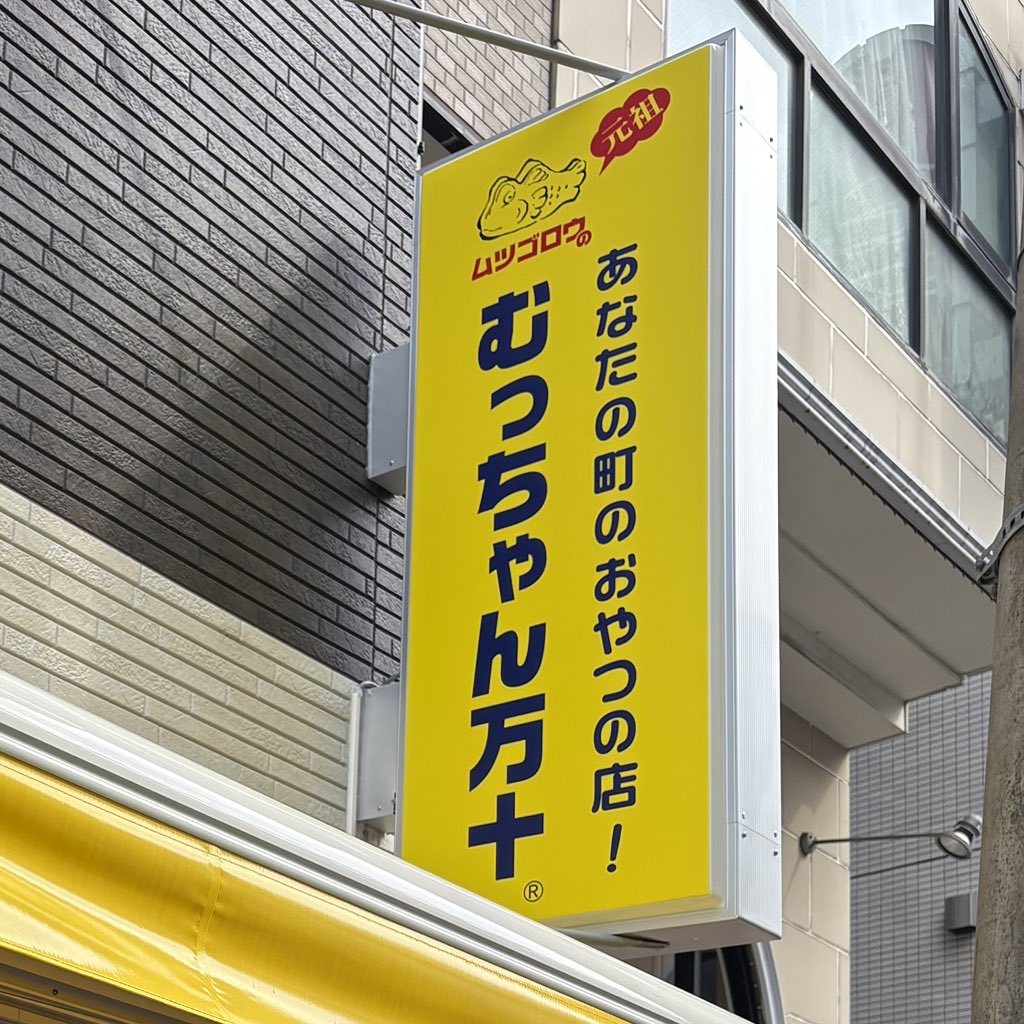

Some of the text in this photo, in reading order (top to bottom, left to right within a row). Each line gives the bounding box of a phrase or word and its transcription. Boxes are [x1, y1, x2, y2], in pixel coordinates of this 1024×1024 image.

[602, 93, 663, 155] 元祖
[471, 216, 592, 281] ムツゴロウの
[468, 281, 550, 880] むっちゃん万十
